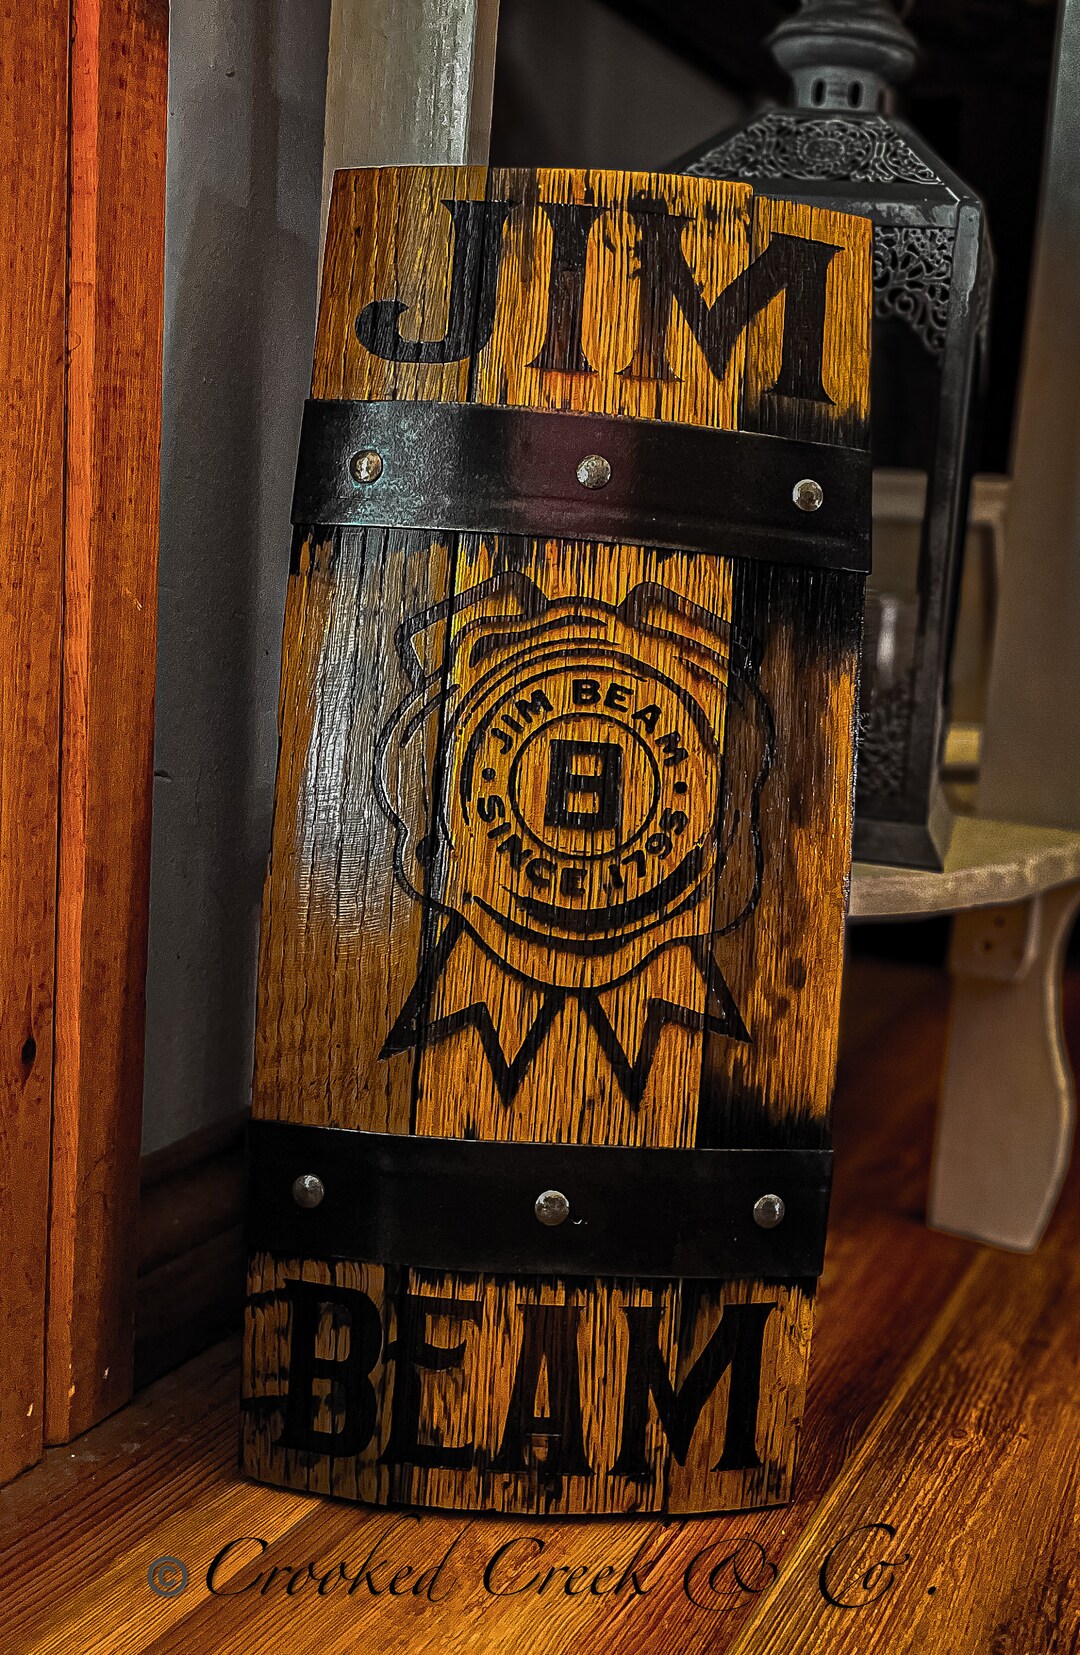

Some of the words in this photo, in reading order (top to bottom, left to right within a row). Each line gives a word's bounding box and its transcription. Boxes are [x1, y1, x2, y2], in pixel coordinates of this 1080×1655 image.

[354, 199, 846, 406] JIM
[490, 689, 554, 755] JIM
[571, 678, 689, 768] BEAM
[543, 738, 624, 831] B
[476, 794, 588, 897] SINCE
[603, 807, 690, 889] 1795
[273, 1277, 778, 1476] BEAM
